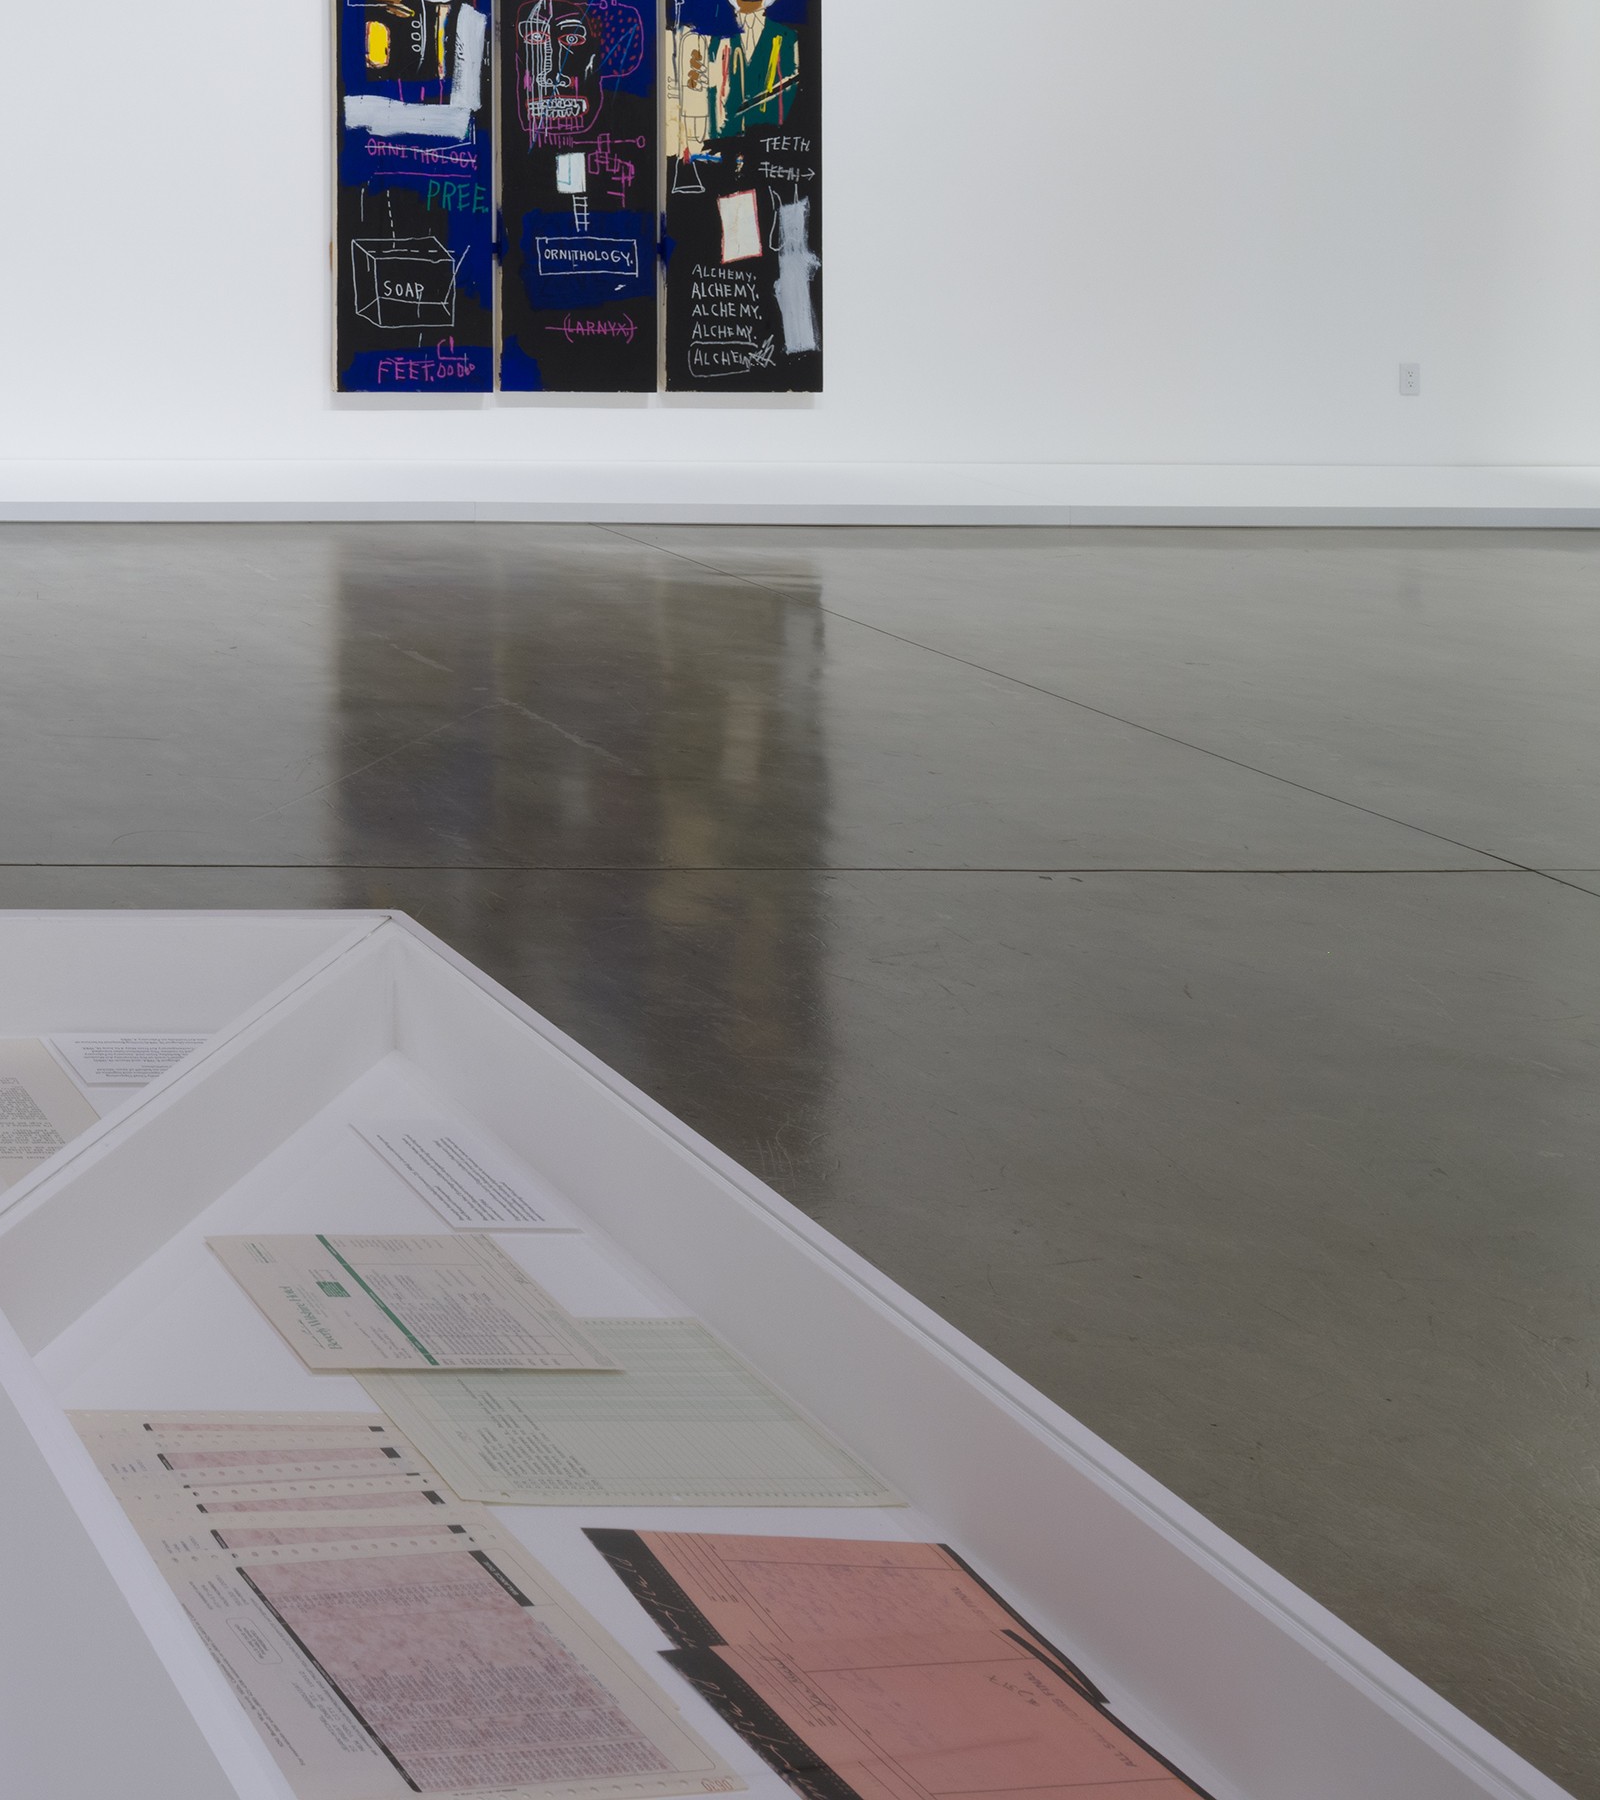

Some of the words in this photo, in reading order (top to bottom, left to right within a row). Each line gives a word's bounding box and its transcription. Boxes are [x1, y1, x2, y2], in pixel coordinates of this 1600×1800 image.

[759, 136, 811, 153] TEETH
[544, 249, 634, 267] ORNITHOLOGY.
[383, 279, 425, 300] SOAP
